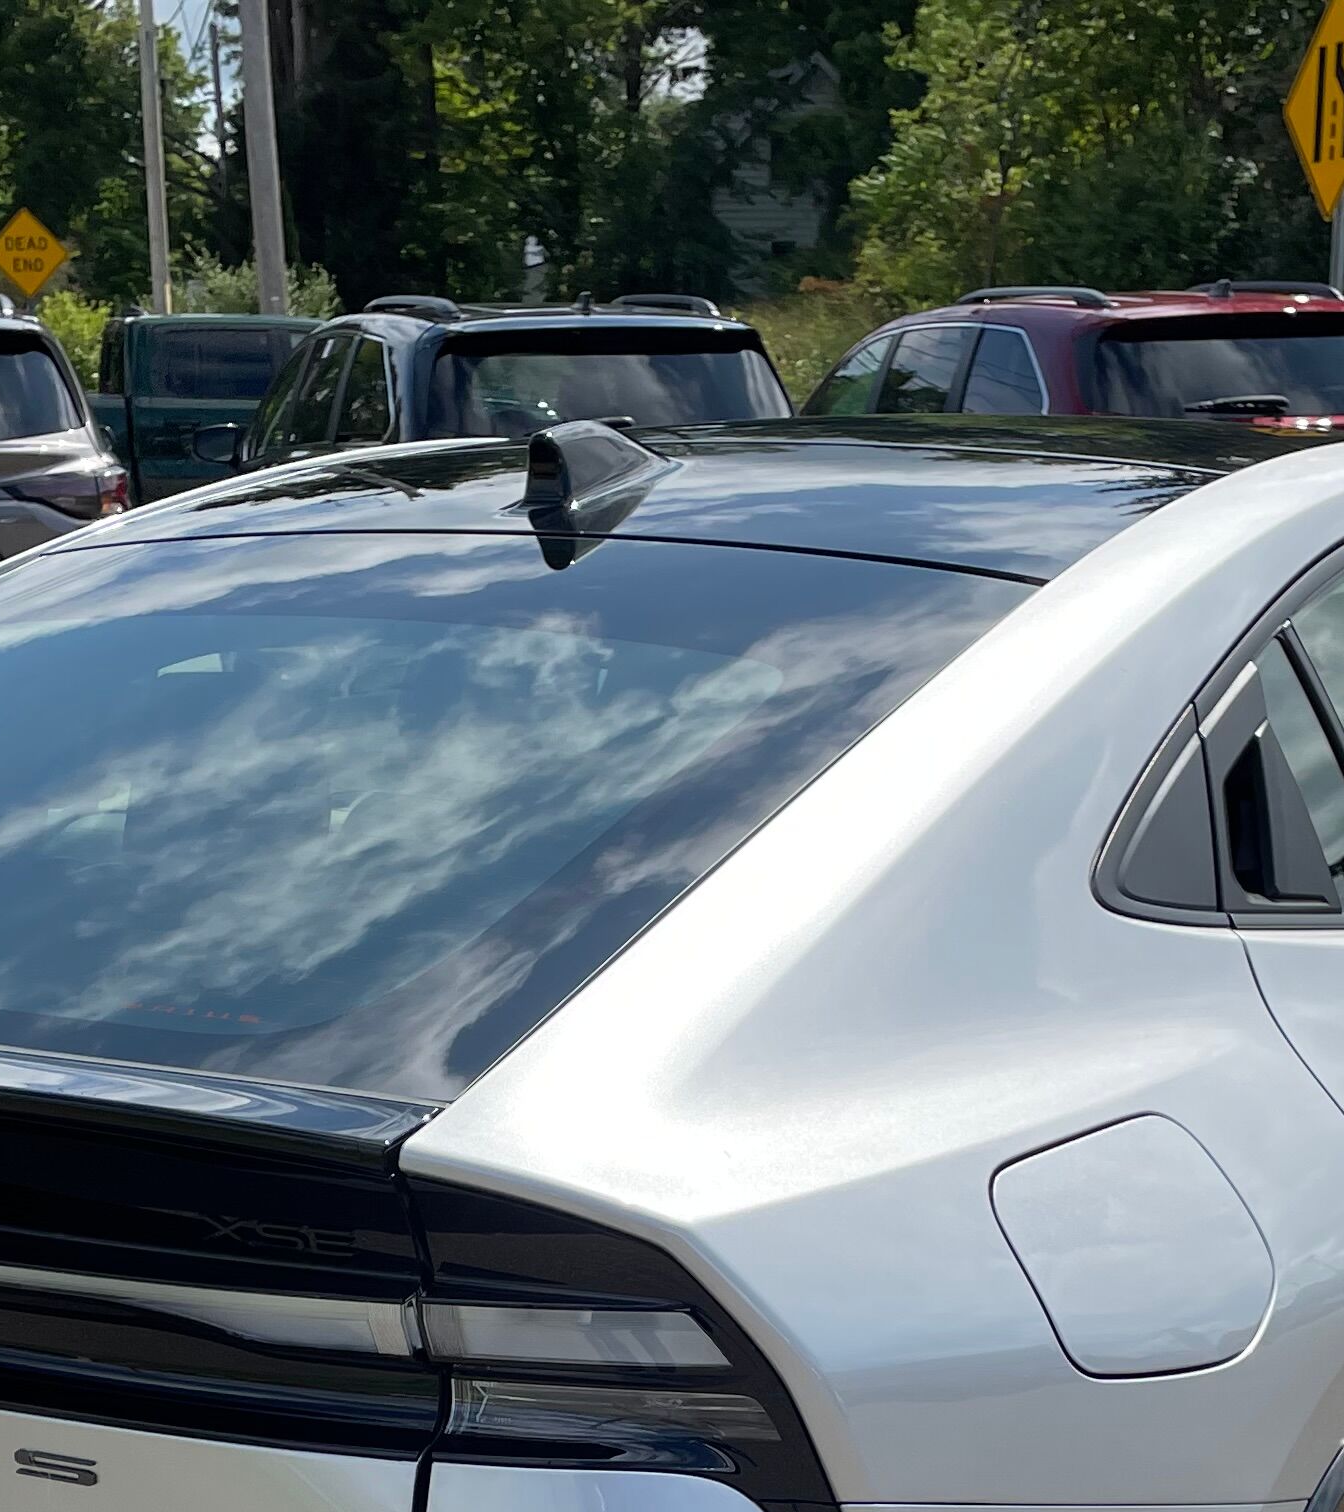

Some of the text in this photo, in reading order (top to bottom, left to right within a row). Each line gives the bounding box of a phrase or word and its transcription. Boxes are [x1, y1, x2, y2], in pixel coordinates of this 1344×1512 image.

[4, 236, 48, 251] DEAD
[13, 257, 44, 273] END
[203, 1215, 356, 1257] XSE
